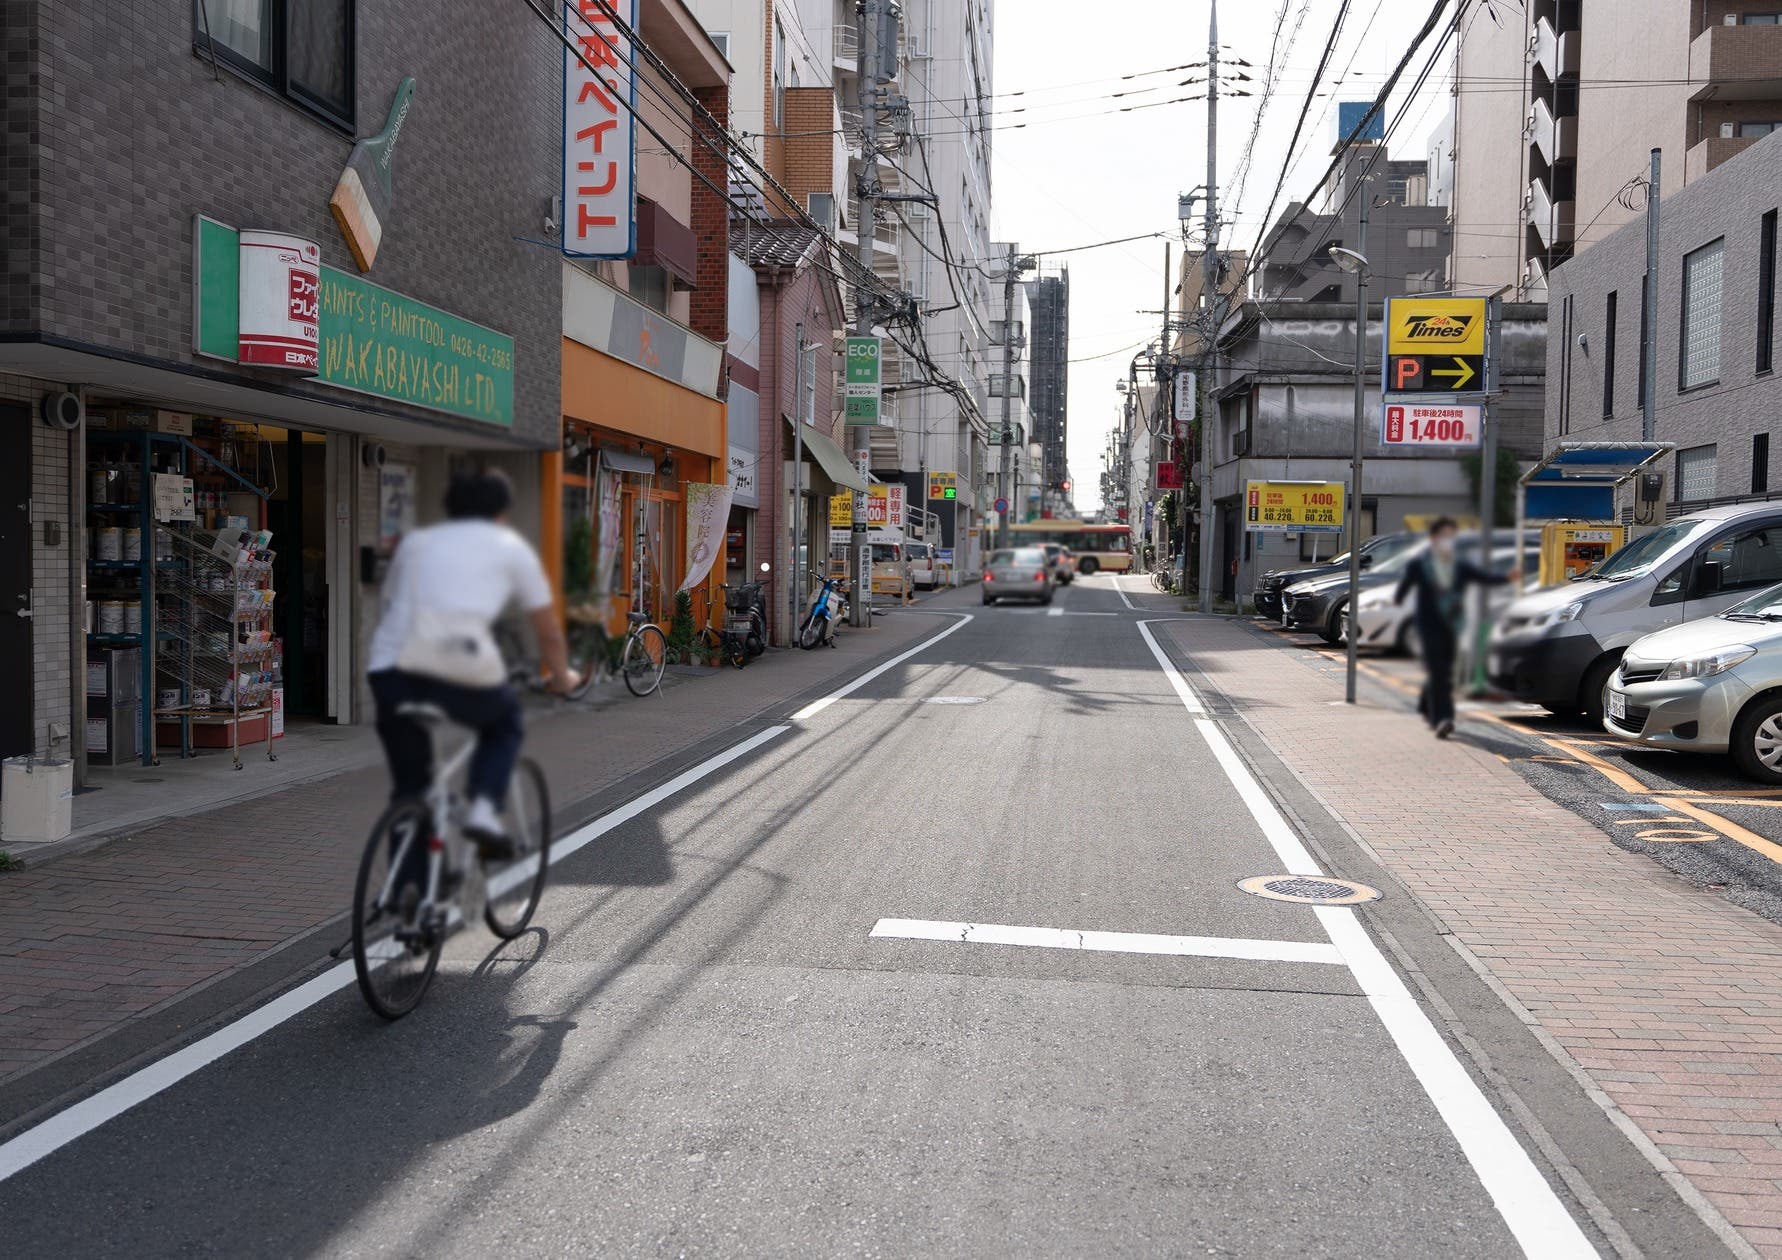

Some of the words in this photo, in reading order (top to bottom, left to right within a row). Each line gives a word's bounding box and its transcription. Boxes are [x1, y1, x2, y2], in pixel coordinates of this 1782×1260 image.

[575, 0, 619, 239] 日本ペイント
[369, 293, 377, 334] &
[1405, 318, 1465, 338] Times
[849, 344, 878, 357] ECO
[326, 334, 459, 405] WAKABAYASHI
[1397, 358, 1420, 389] P
[931, 486, 941, 497] P
